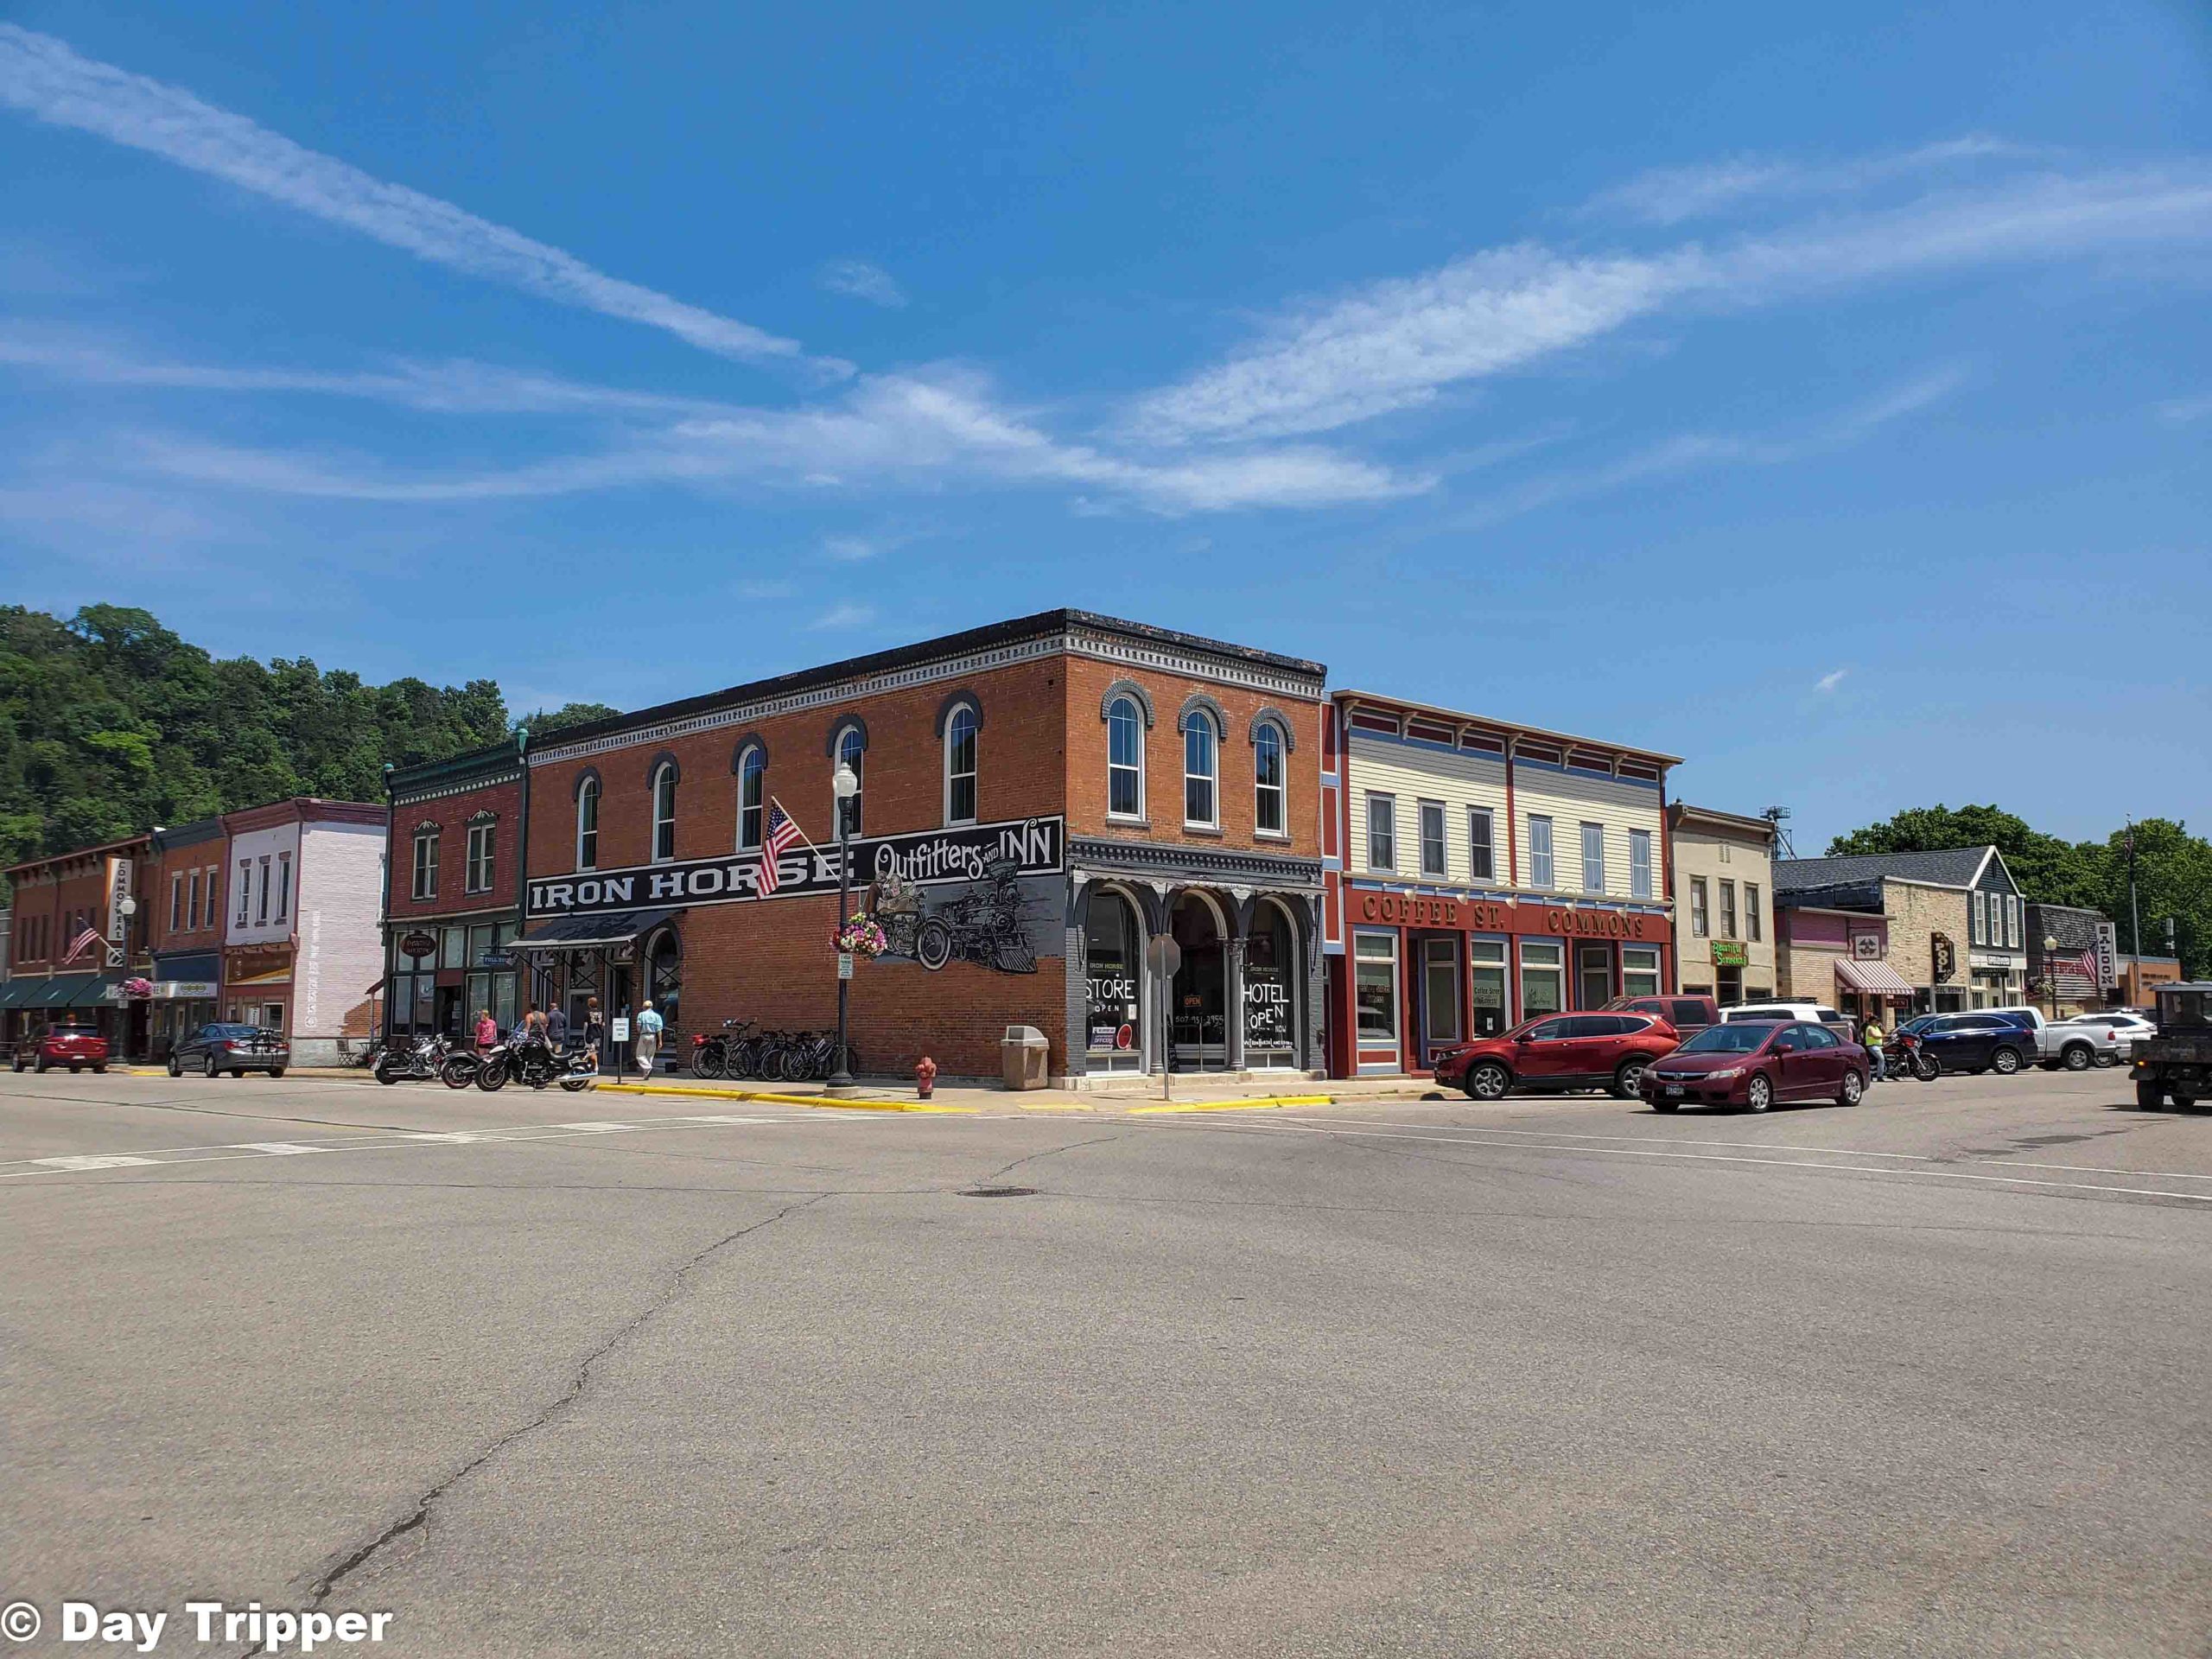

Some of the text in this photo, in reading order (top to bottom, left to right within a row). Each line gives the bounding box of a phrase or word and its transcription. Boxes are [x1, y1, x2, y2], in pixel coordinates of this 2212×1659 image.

[532, 818, 1052, 910] IRON HORSE Outfitters AND INN
[114, 861, 126, 938] COMMONWEAL
[1363, 895, 1643, 937] COFFEE ST. COMMONS
[1935, 942, 1949, 974] POOL
[2099, 926, 2113, 984] SALOON
[1085, 978, 1135, 1000] STORE
[1243, 983, 1290, 1003] HOTEL
[1249, 1004, 1284, 1028] OPEN
